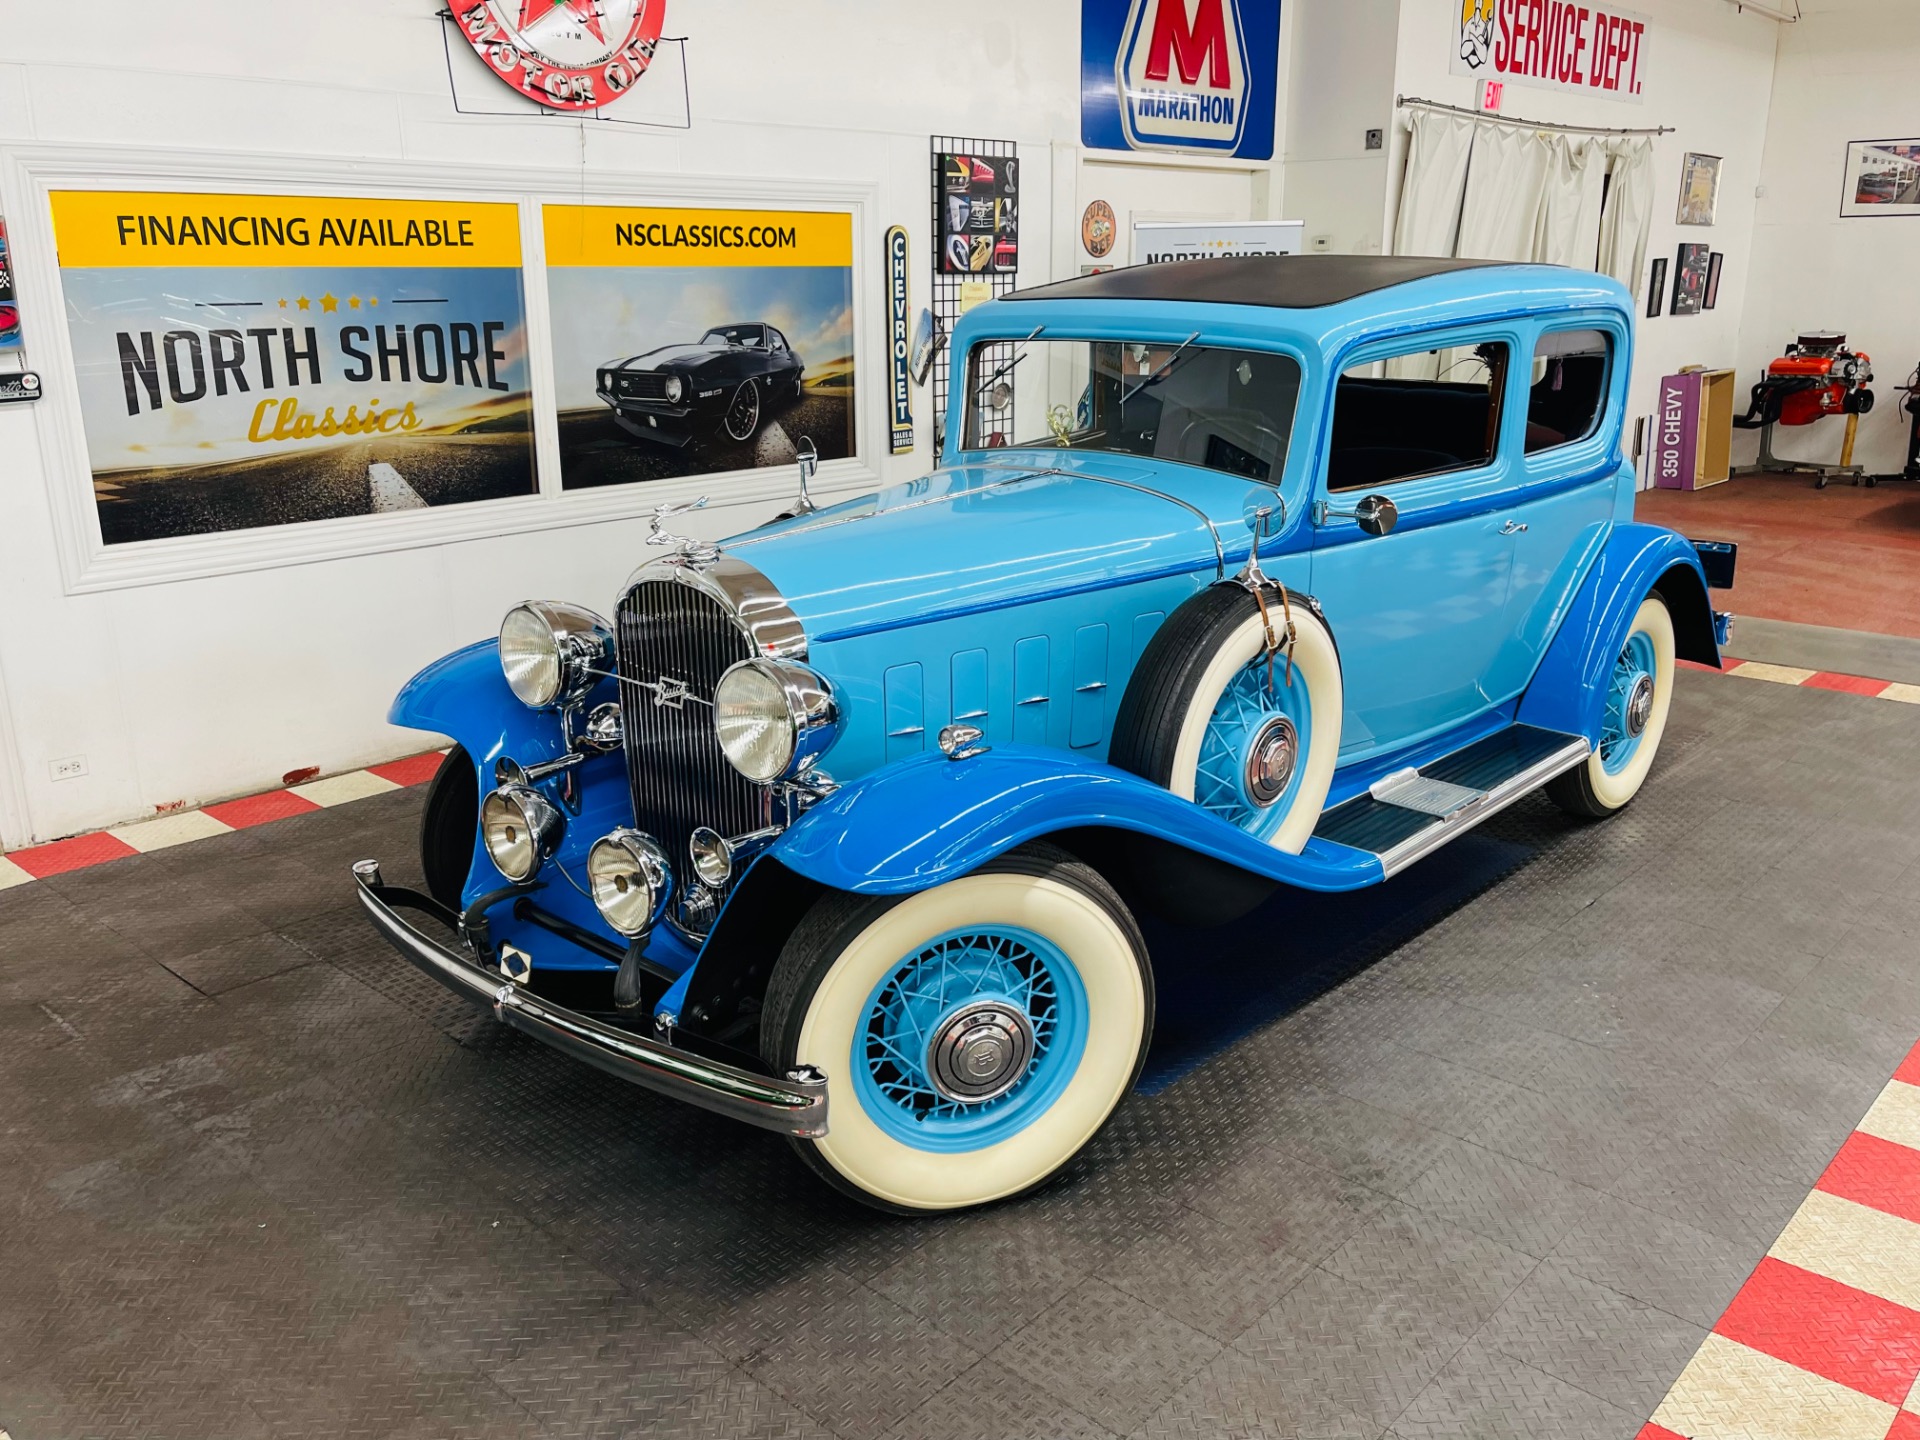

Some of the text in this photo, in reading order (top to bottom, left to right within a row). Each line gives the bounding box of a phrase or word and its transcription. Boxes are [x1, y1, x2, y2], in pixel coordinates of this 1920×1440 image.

[461, 3, 598, 106] MOTOR
[1144, 0, 1231, 90] M
[1495, 0, 1645, 94] SERVICE DEPT.
[1138, 87, 1234, 125] MARATHON
[1485, 81, 1503, 110] EXIT
[117, 215, 474, 247] FINANCING AVAILABLE
[615, 223, 796, 248] NSCLASSICS.COM
[1089, 234, 1111, 255] BEE
[893, 237, 907, 420] CHEVROLET
[116, 321, 509, 416] NORTH SHORE
[248, 397, 423, 443] Classics
[893, 437, 913, 447] SERVICE
[1662, 387, 1683, 478] 350 CHEVY
